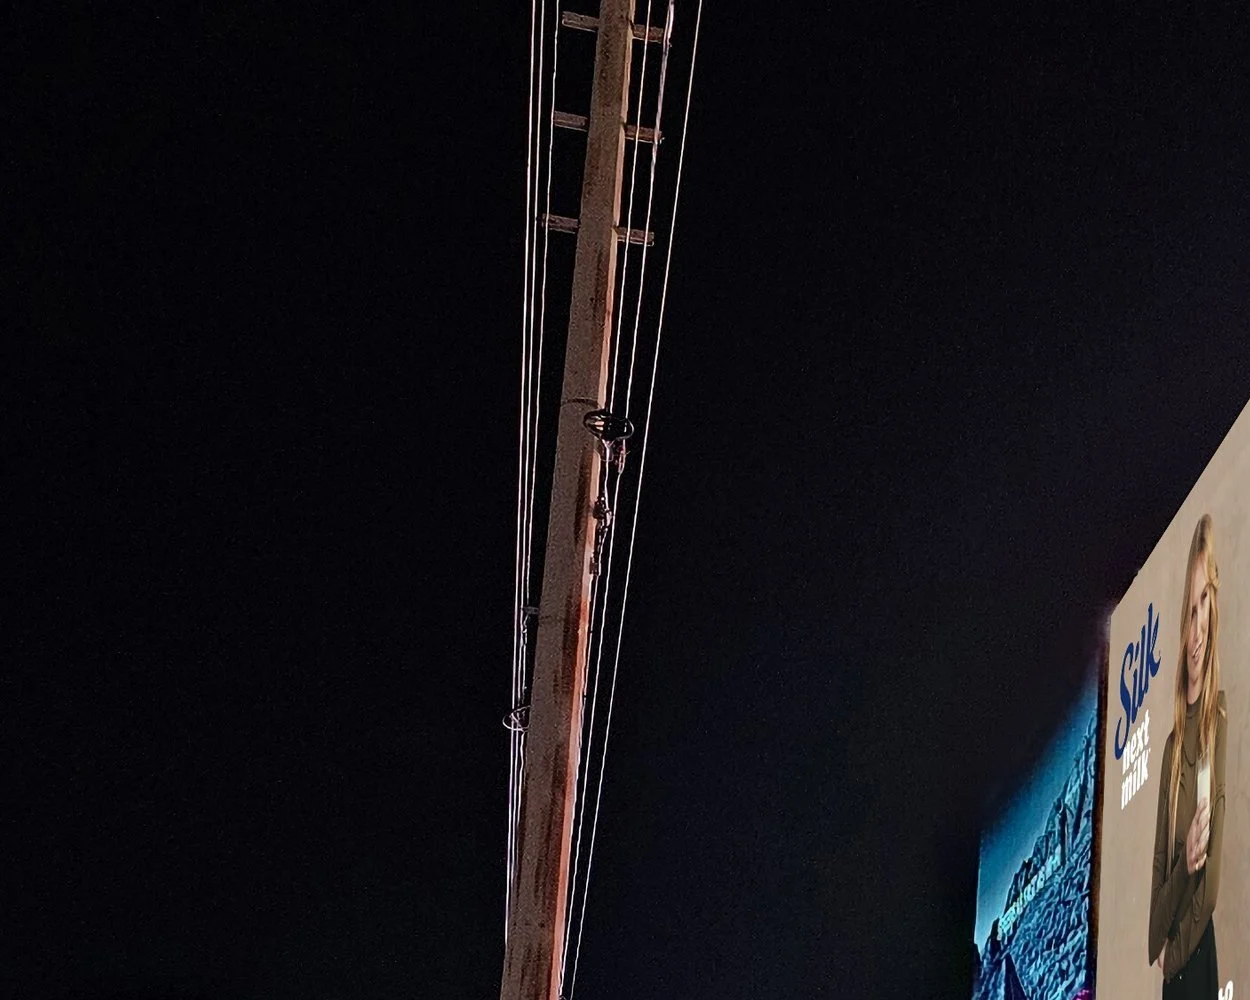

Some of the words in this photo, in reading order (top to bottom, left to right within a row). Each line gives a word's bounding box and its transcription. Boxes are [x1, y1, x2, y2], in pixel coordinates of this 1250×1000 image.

[1115, 602, 1161, 760] Silk
[1123, 709, 1150, 775] next
[1121, 752, 1149, 810] milk
